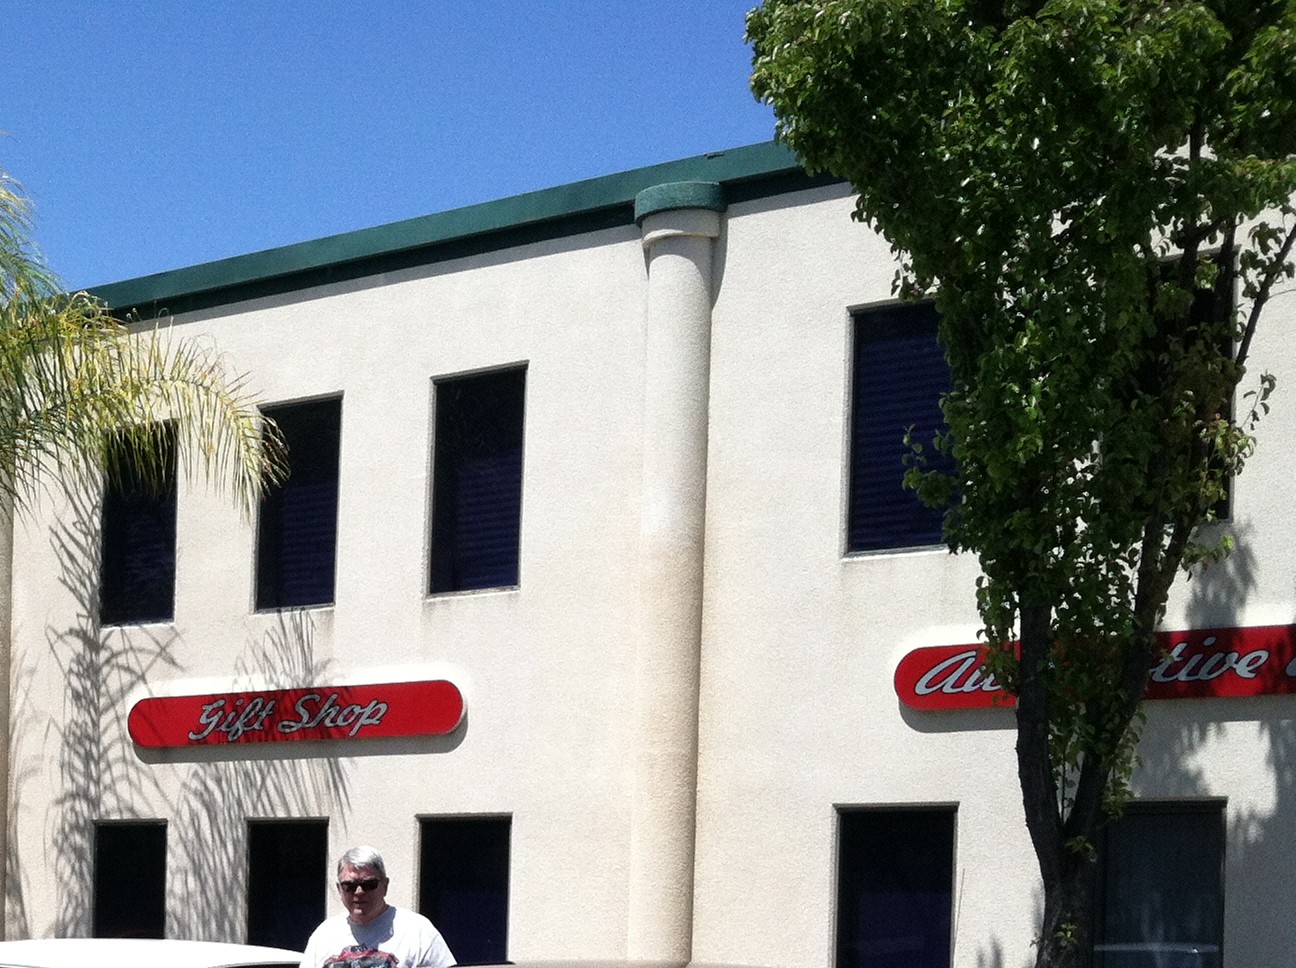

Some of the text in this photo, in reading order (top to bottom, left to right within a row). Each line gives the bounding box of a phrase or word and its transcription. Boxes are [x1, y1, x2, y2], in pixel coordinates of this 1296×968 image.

[913, 635, 1271, 697] Autive
[187, 692, 390, 742] Gift Shop
